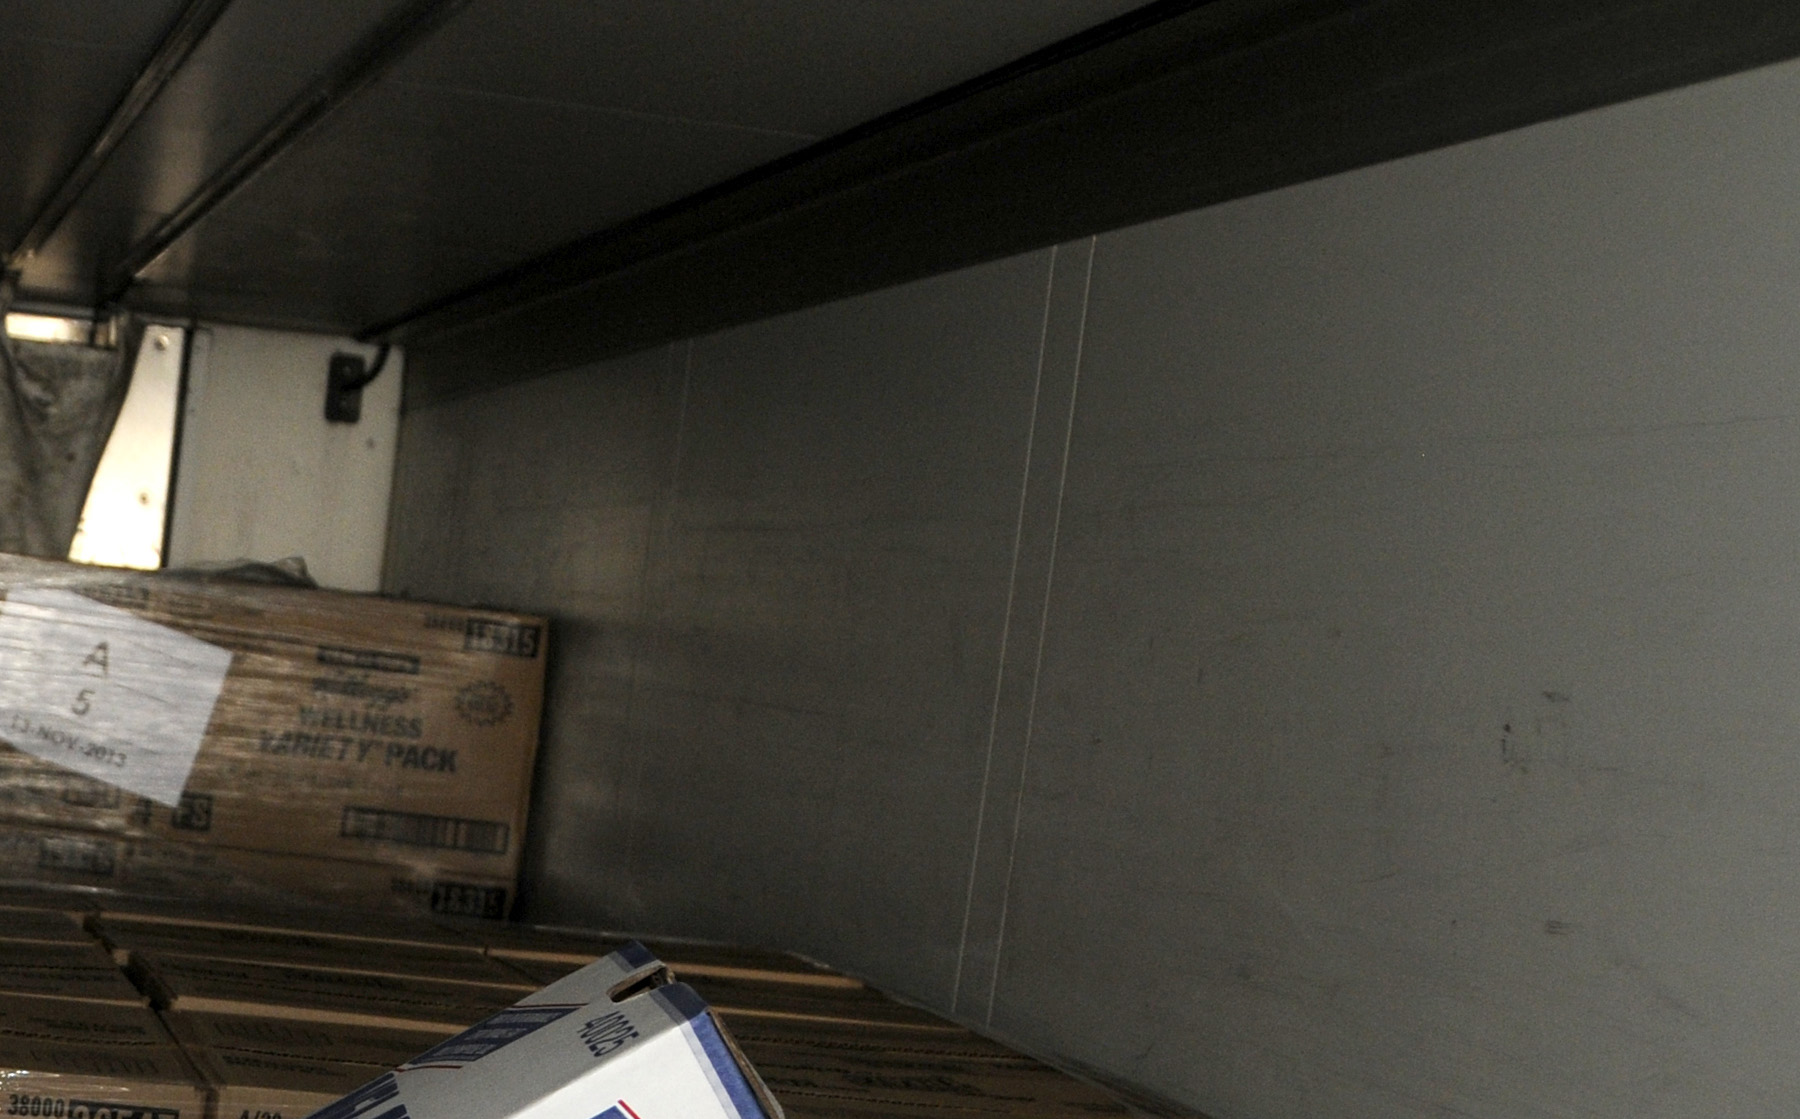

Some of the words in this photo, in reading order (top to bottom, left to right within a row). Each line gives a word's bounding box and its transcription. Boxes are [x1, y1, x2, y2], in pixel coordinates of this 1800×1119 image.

[71, 689, 96, 716] 5
[383, 741, 458, 773] PACK
[578, 1010, 641, 1057] 40025
[8, 1094, 64, 1117] 38000
